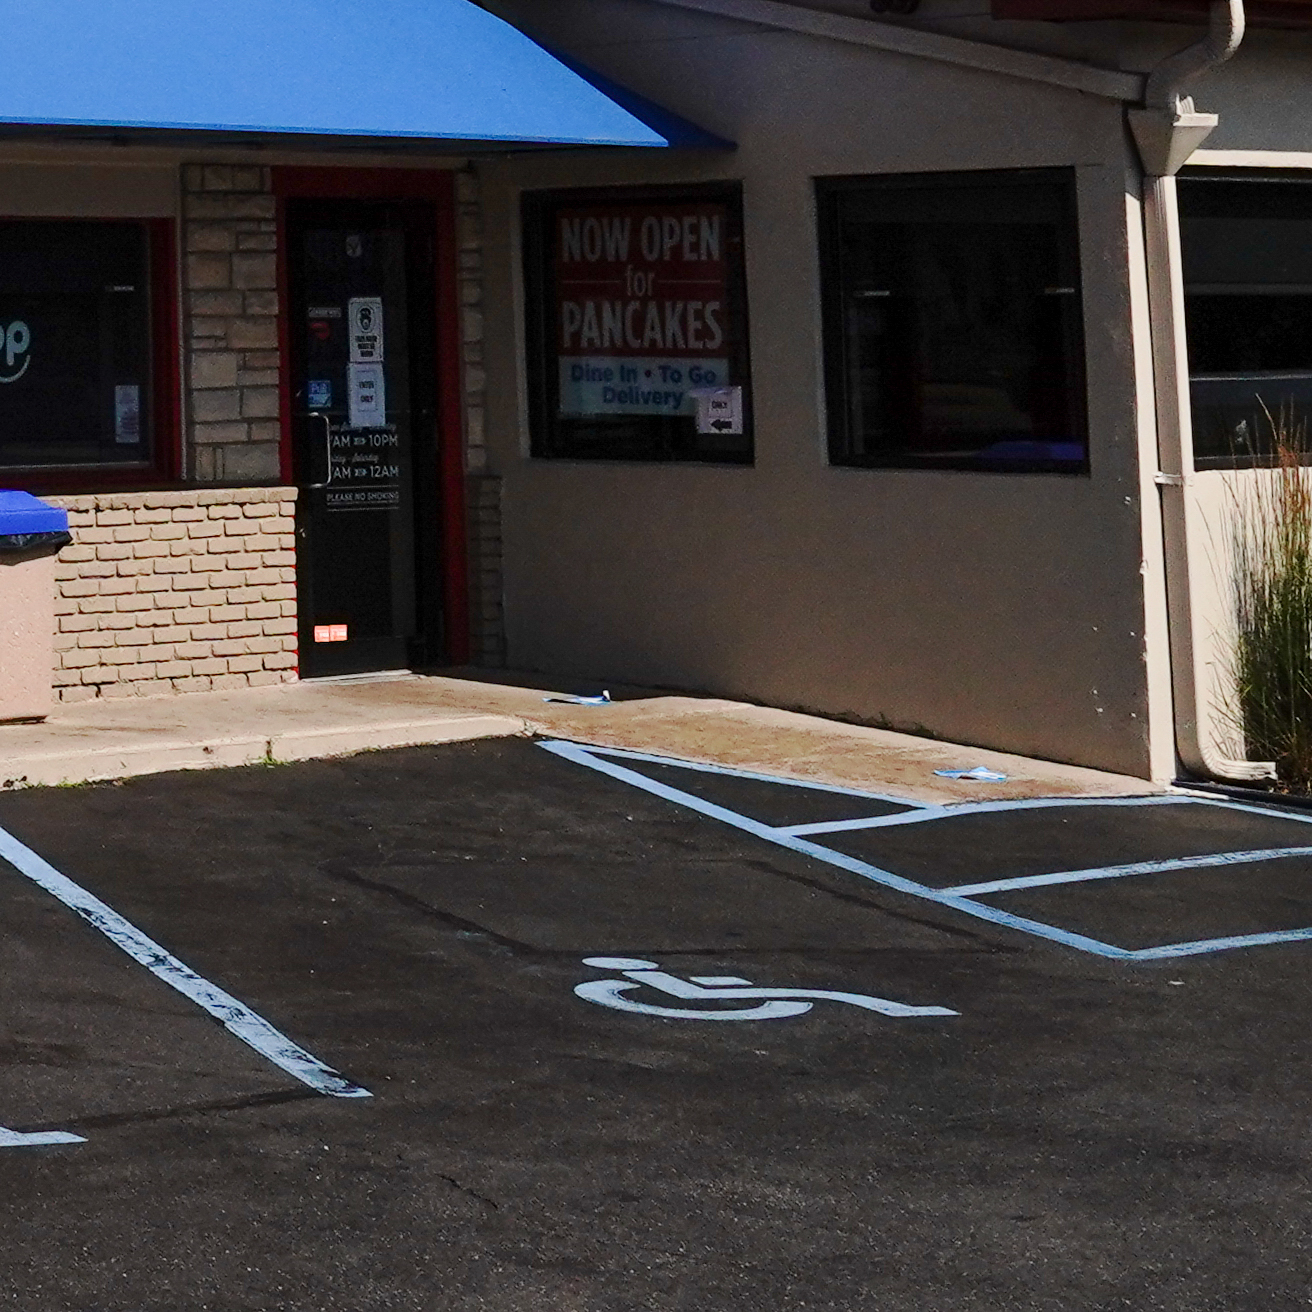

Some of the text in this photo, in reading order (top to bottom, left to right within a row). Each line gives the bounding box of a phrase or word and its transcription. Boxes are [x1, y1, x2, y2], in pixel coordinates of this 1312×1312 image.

[560, 215, 721, 263] NOW OPEN
[625, 263, 655, 297] for
[561, 300, 723, 349] PANCAKES
[571, 363, 717, 384] Dine In To Go
[603, 386, 684, 410] Delivery
[368, 433, 398, 447] 10PM
[369, 465, 399, 478] 12AM
